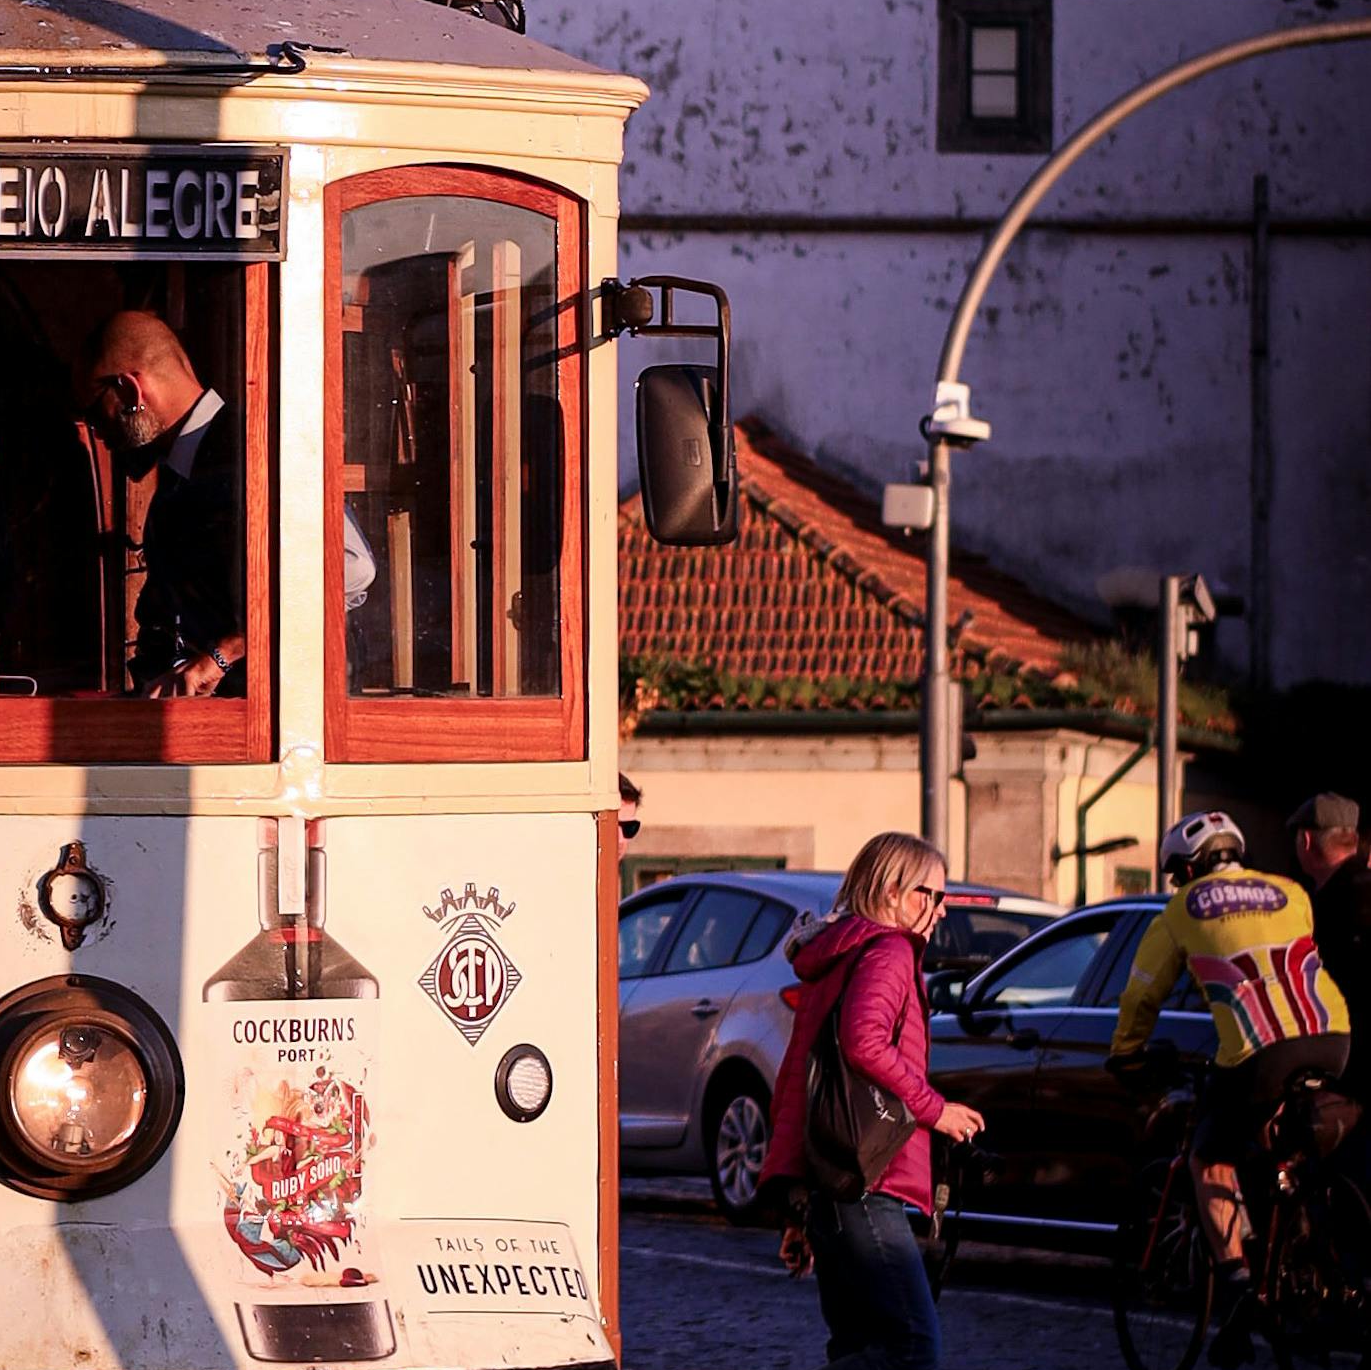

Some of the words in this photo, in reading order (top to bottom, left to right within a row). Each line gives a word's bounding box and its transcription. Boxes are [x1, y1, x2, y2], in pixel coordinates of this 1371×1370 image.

[84, 166, 260, 239] ALEGRE
[1197, 885, 1278, 909] COSMOS
[278, 1049, 315, 1062] PORT
[271, 1173, 307, 1200] RUBY
[309, 1155, 342, 1185] SOHO
[436, 1237, 484, 1253] TAILS
[495, 1238, 518, 1253] OF
[529, 1239, 561, 1255] THE
[416, 1263, 588, 1301] UNEXPECTED
